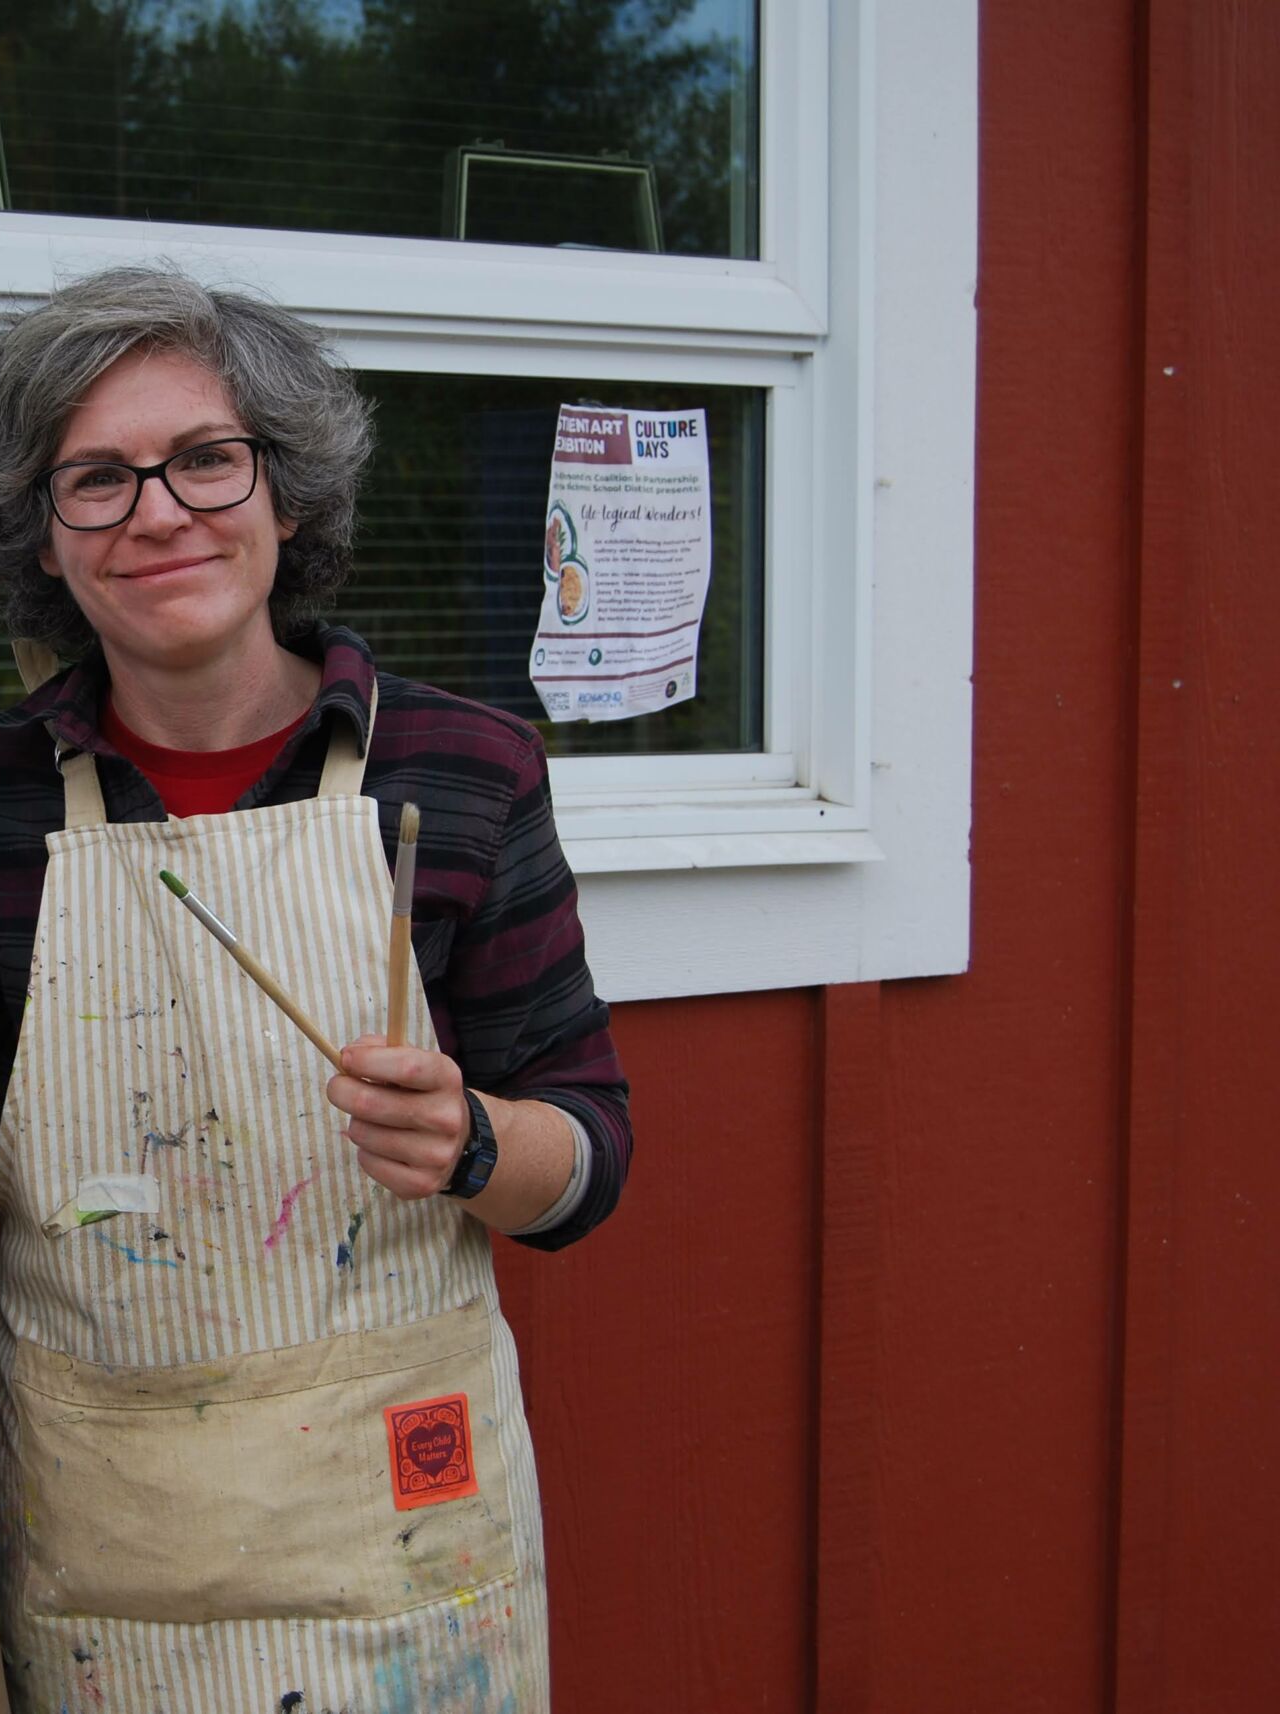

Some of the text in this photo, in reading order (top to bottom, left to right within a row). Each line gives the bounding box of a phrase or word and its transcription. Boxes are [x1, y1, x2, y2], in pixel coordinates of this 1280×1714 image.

[590, 419, 623, 435] ART
[635, 418, 697, 439] CULTURE
[636, 440, 669, 459] DAYS
[411, 1434, 452, 1452] Every Child
[419, 1450, 447, 1462] Matters
